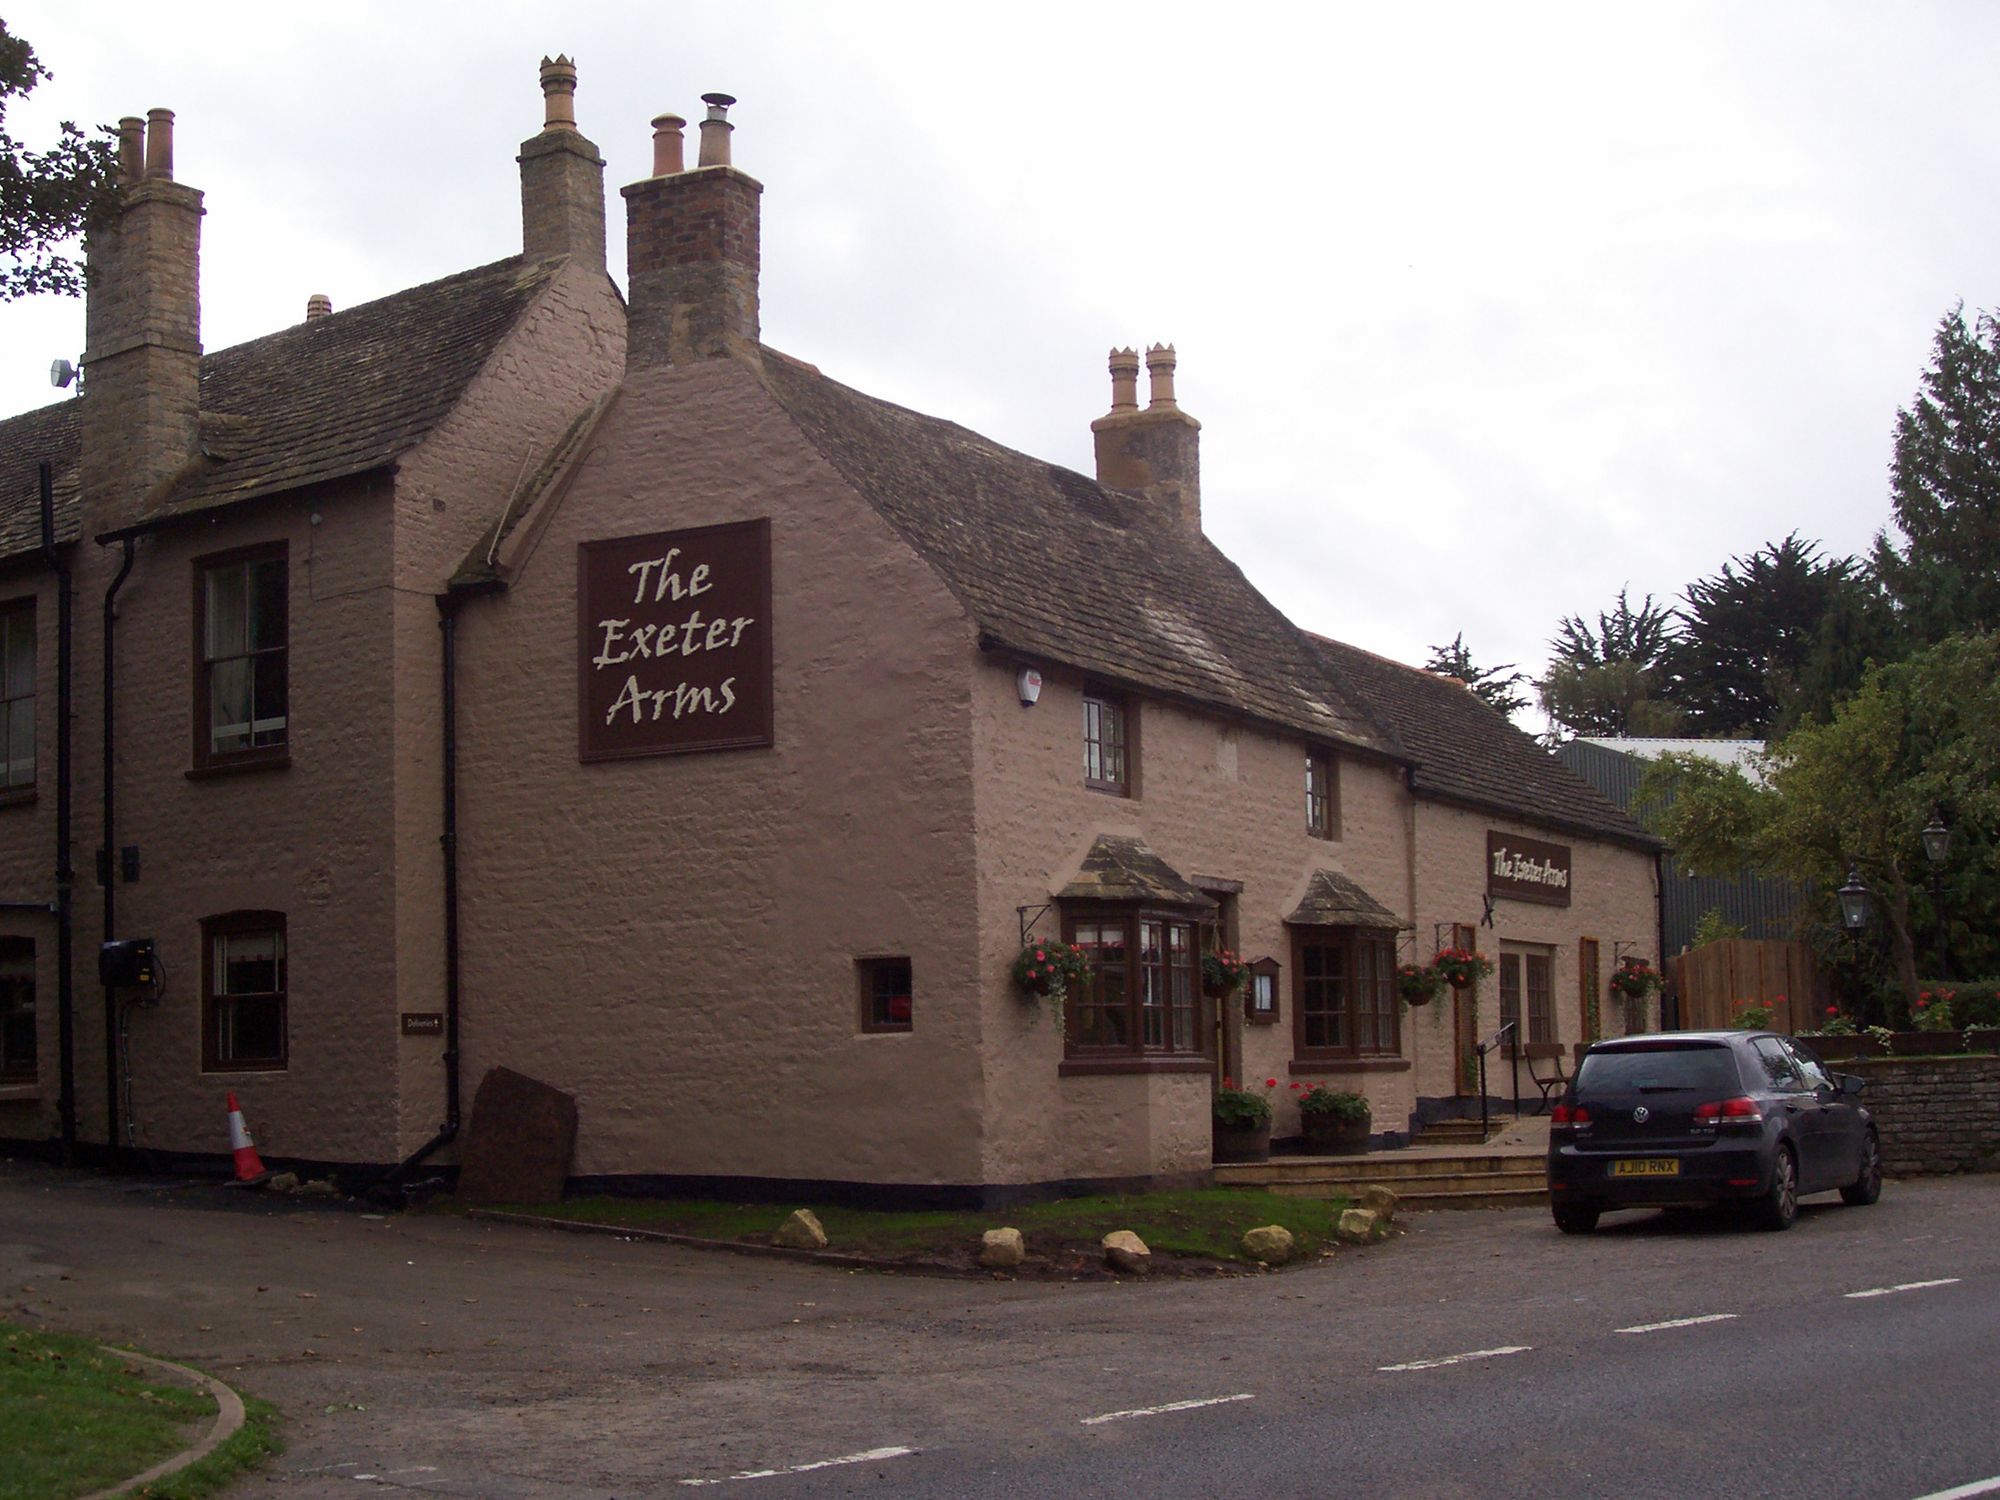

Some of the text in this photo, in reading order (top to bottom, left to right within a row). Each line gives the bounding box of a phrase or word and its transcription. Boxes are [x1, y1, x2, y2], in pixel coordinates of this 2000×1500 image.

[628, 548, 712, 603] The
[593, 610, 754, 669] Exeter
[606, 675, 736, 725] Arms
[1493, 848, 1567, 888] The Exeter Arms
[1619, 1160, 1674, 1173] AJ10 RNX
